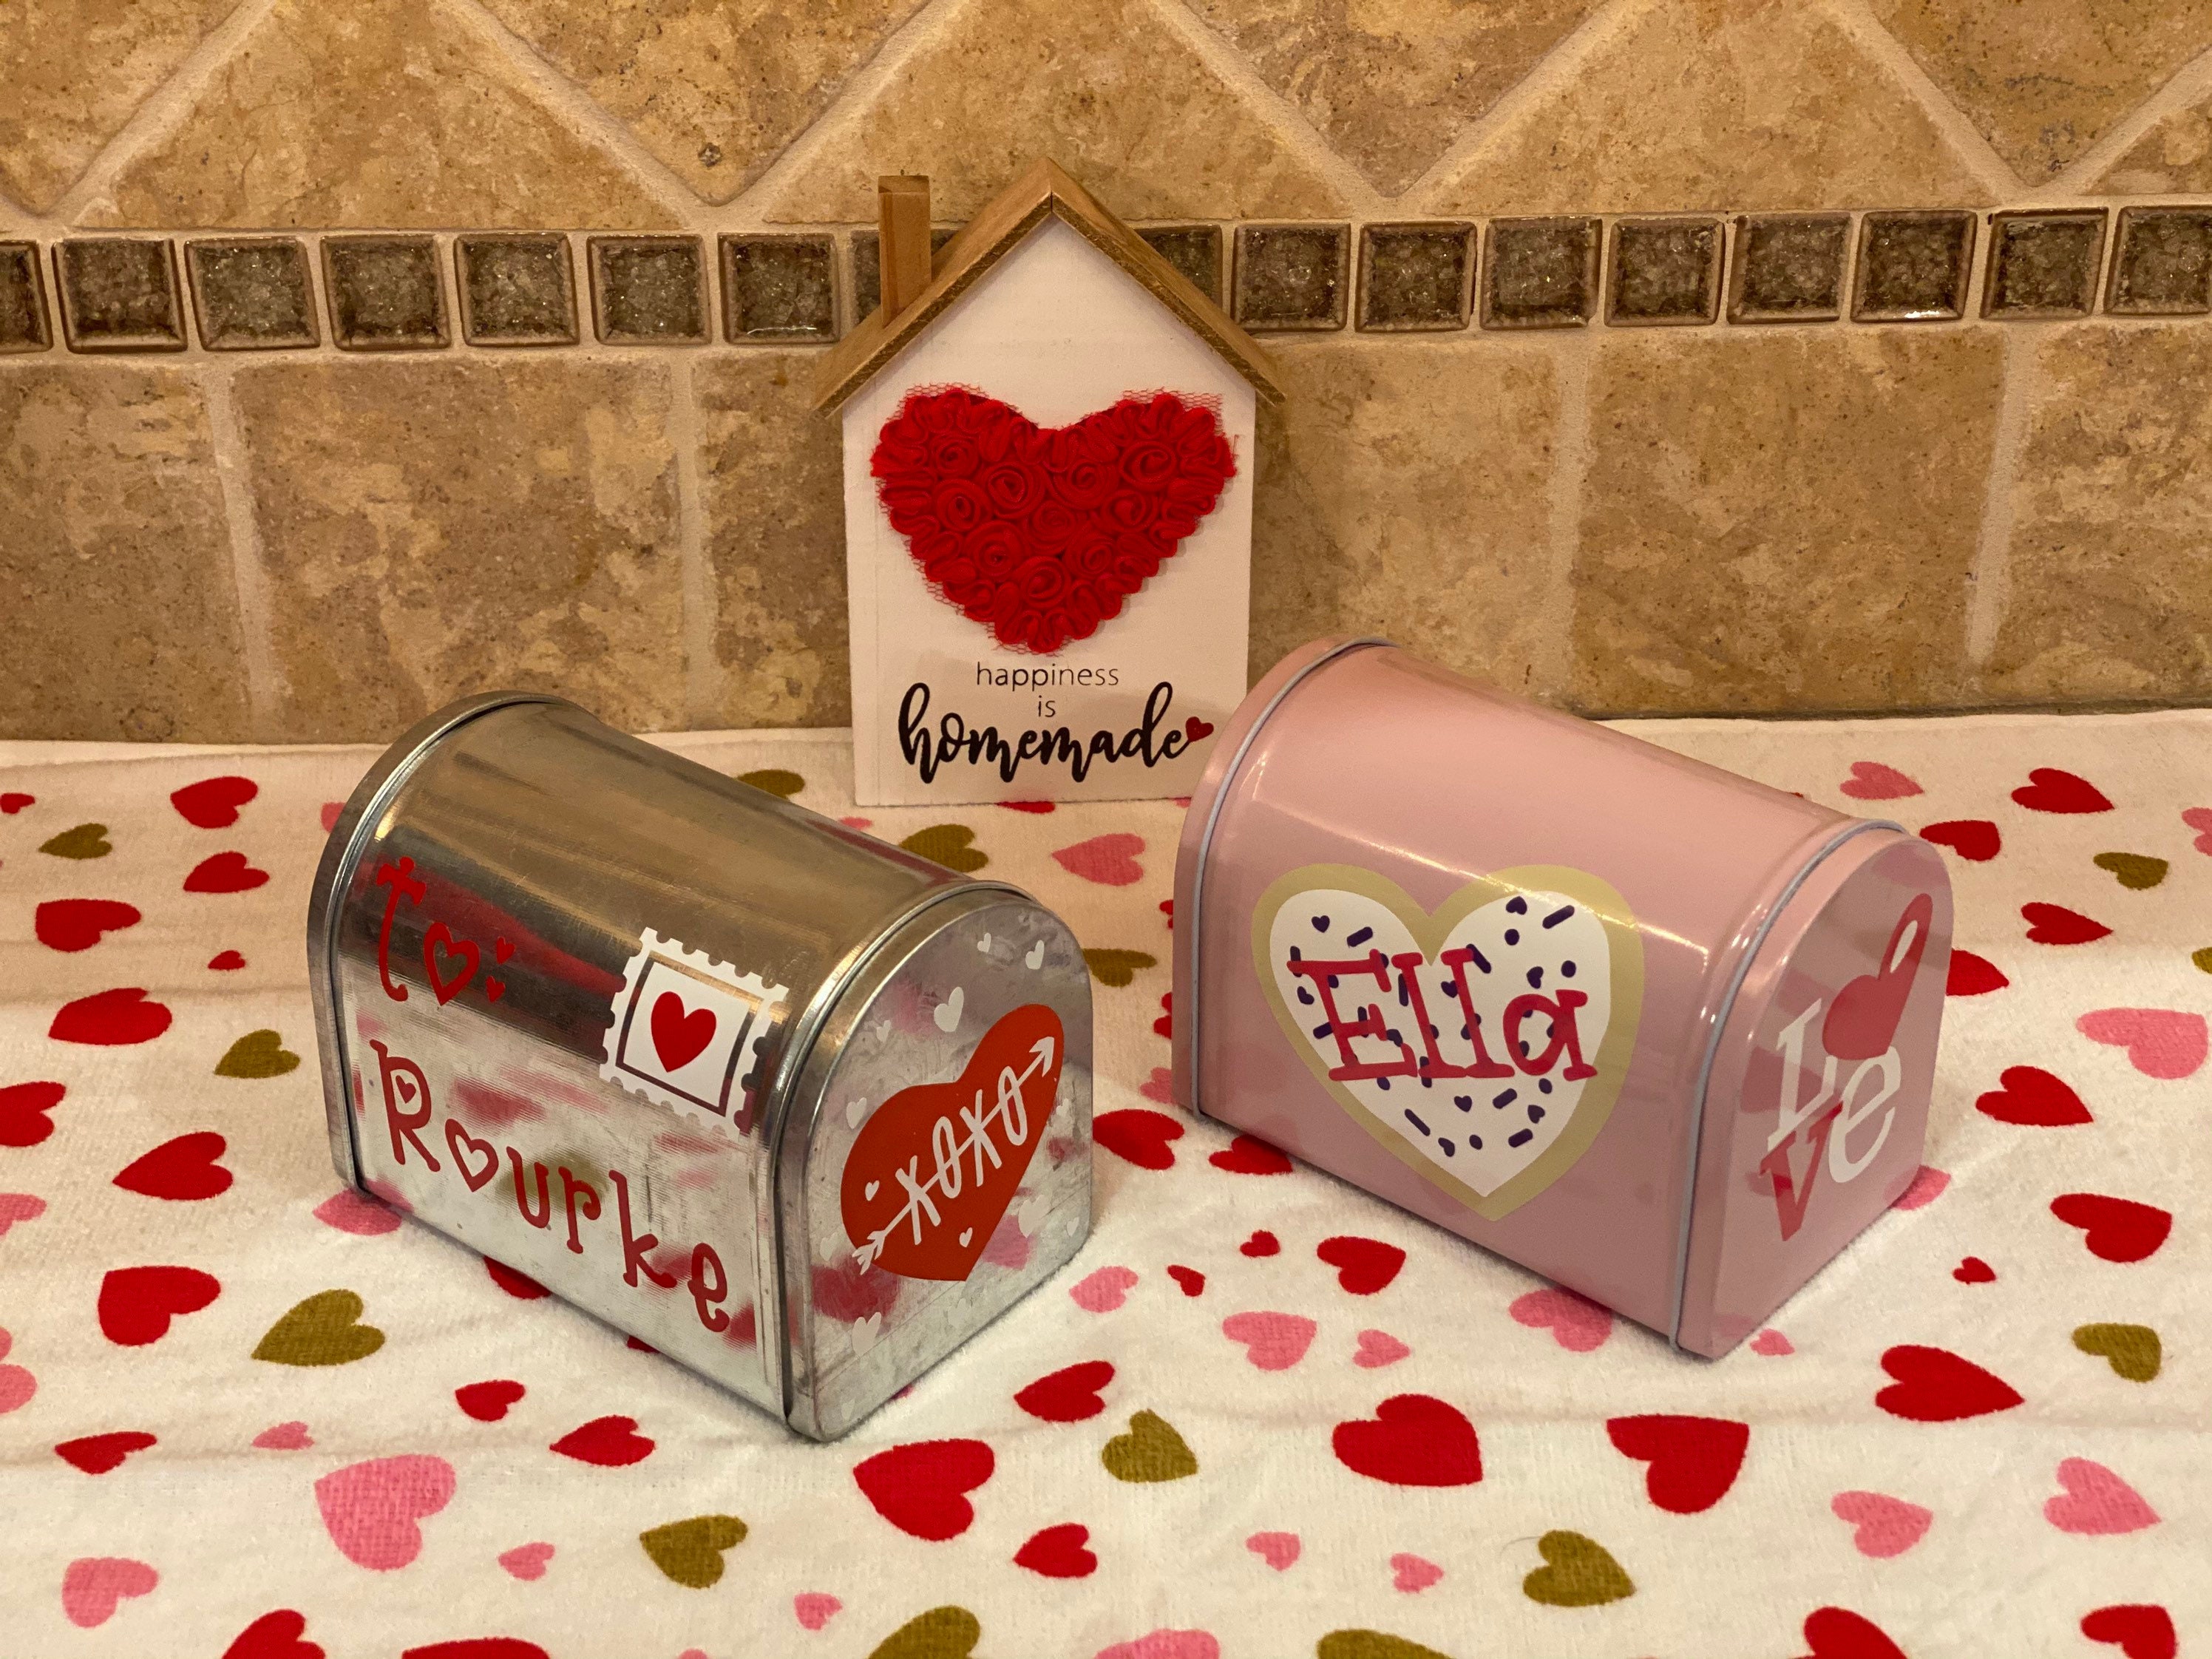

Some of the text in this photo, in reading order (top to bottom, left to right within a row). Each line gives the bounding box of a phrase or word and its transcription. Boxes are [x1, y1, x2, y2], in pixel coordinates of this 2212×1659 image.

[976, 662, 1119, 692] happiness
[1037, 695, 1056, 718] is
[898, 682, 1192, 784] homemade
[1286, 949, 1598, 1082] Ella
[370, 1039, 730, 1332] Rourke
